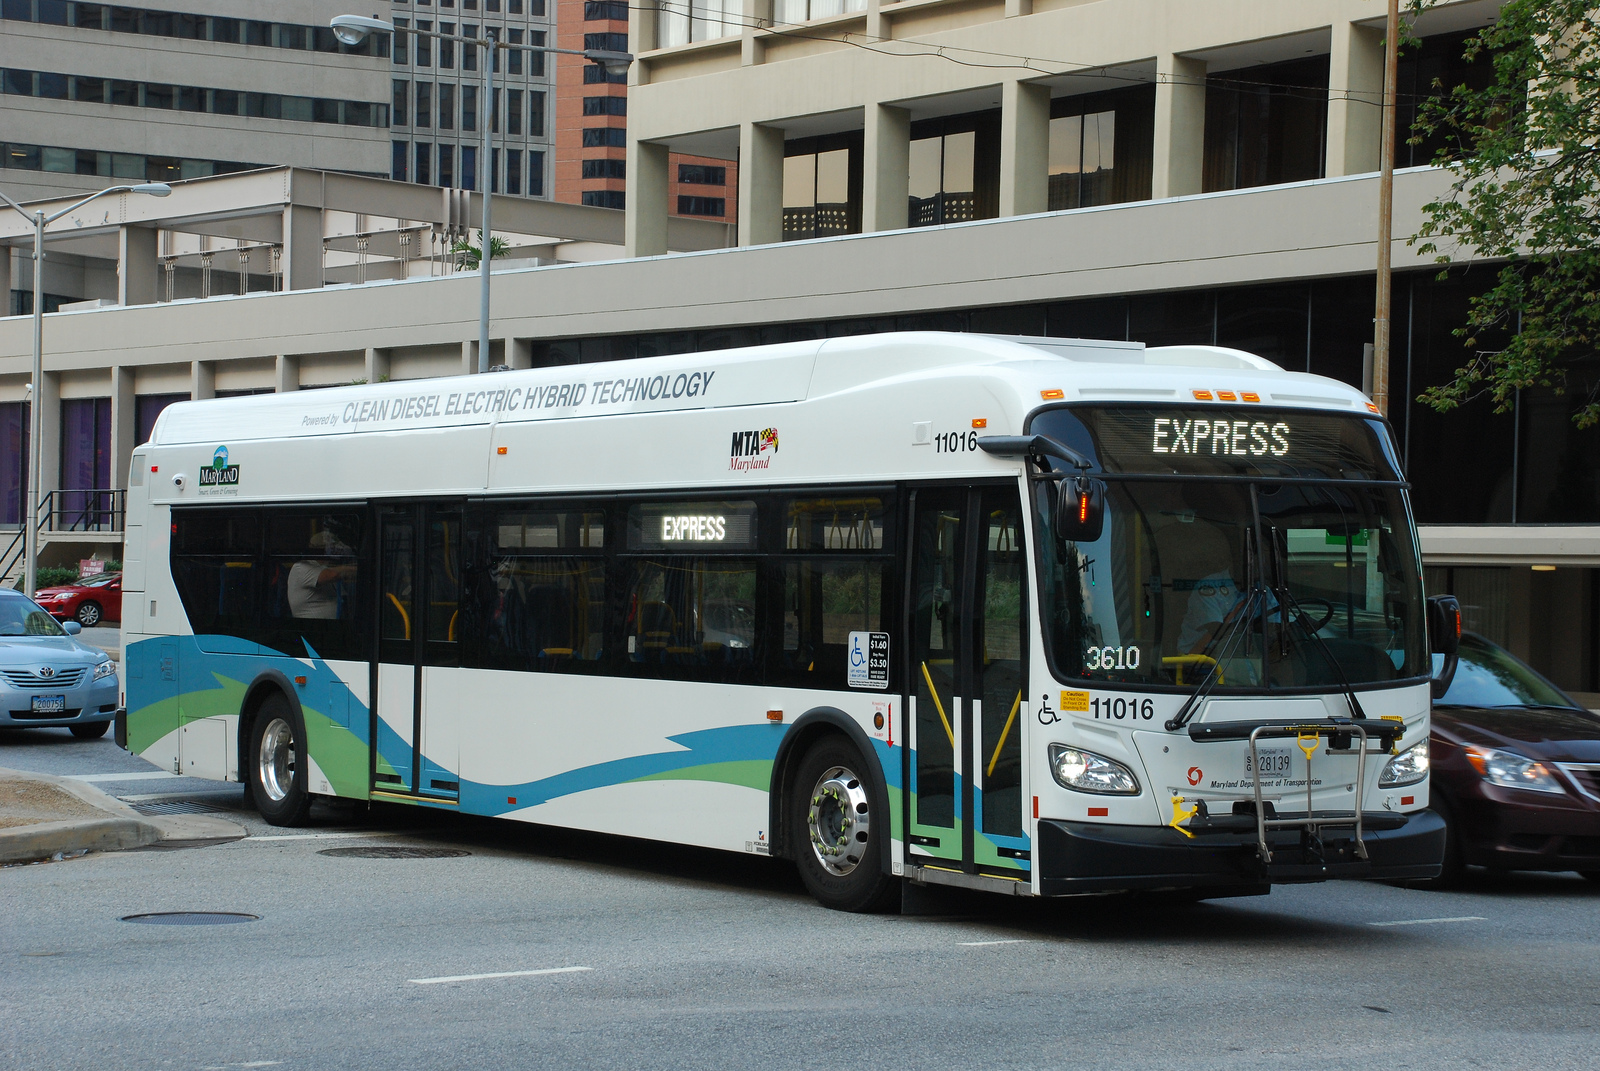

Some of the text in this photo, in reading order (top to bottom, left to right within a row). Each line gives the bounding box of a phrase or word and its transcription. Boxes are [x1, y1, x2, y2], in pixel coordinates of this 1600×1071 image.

[302, 371, 716, 427] Powered by CLEAN DIESEL ELECTRIC HYBRID TECHNOLOGY
[731, 431, 760, 457] MTA
[935, 431, 977, 453] 11016
[1153, 418, 1290, 456] EXPRESS
[728, 456, 771, 473] Maryland
[662, 515, 727, 541] EXPRESS
[870, 639, 887, 650] $1.60
[869, 658, 887, 668] $3.50
[1086, 646, 1140, 670] 3610
[1090, 698, 1154, 720] 11016
[1259, 755, 1290, 771] 28139
[1210, 780, 1239, 789] Maryland
[1239, 779, 1274, 789] Depament
[1283, 778, 1322, 788] Transportion
